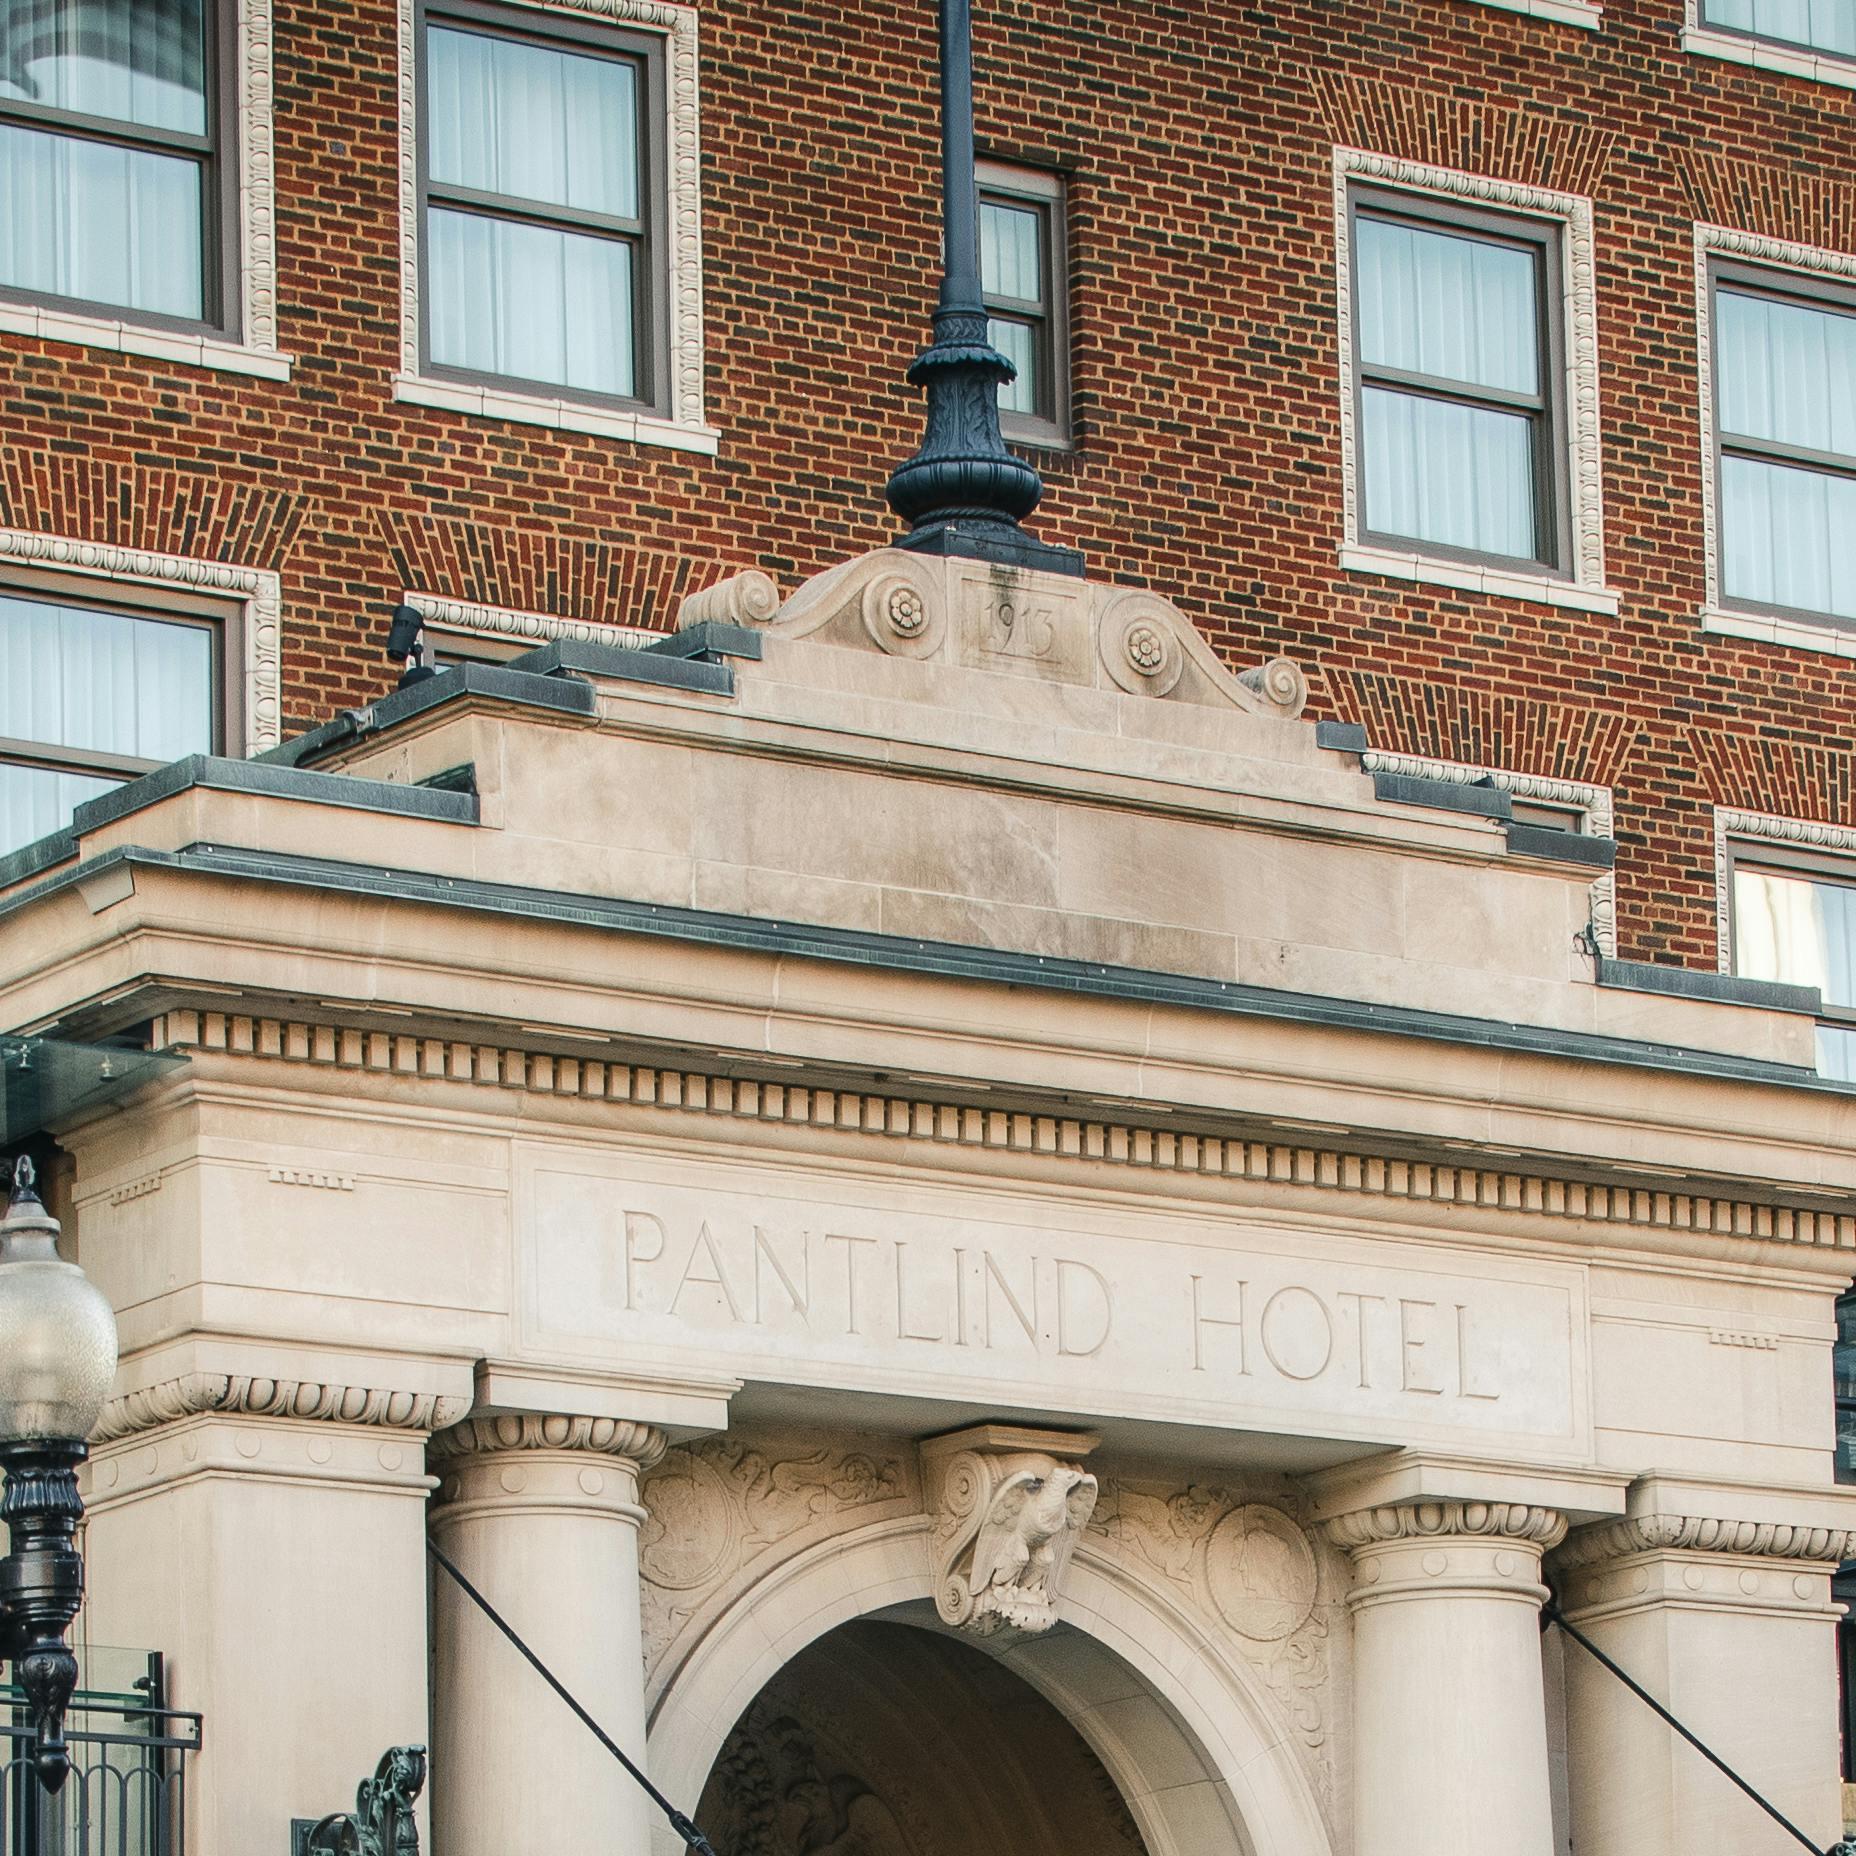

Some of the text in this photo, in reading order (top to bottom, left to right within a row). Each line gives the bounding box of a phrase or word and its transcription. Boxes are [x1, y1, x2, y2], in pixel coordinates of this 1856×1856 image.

[983, 602, 1055, 657] 1913
[622, 1209, 1501, 1401] PANTLIND HOTEL
